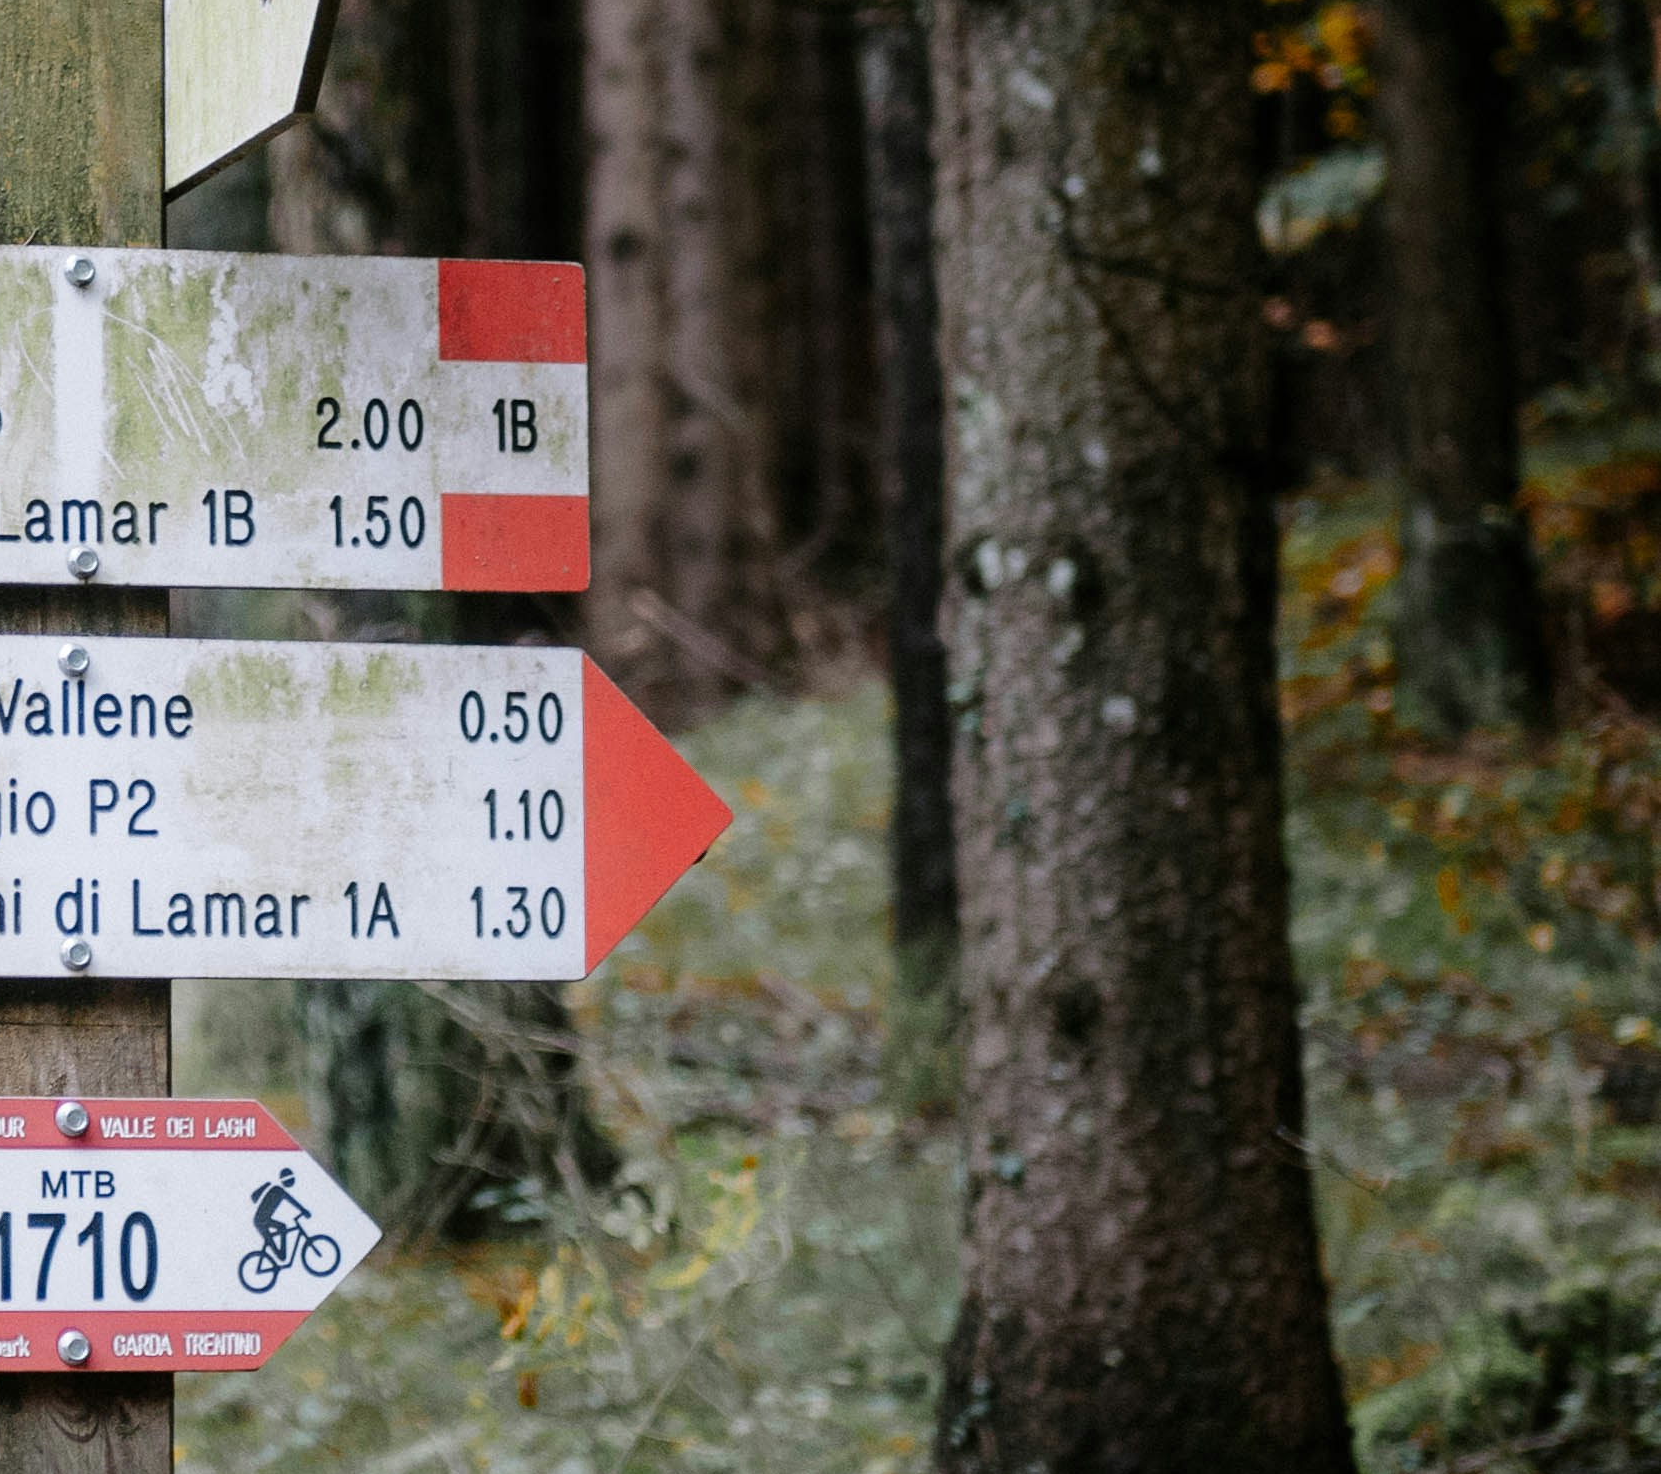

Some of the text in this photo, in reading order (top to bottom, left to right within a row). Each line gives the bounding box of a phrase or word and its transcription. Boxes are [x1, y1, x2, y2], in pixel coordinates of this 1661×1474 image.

[314, 395, 425, 453] 2.00
[490, 397, 540, 455] 1B
[201, 488, 256, 548] 1B
[328, 494, 427, 551] 1.50
[458, 689, 564, 745] 0.50
[88, 777, 160, 837] P2
[482, 787, 565, 842] 1.10
[54, 876, 100, 937] di
[131, 877, 312, 939] Lamar
[342, 880, 401, 939] 1A
[469, 885, 567, 940] 1.30
[99, 1116, 156, 1139] VALLE
[165, 1116, 195, 1139] DEI
[204, 1116, 256, 1139] LAGHI
[41, 1169, 117, 1200] MTB
[112, 1333, 174, 1357] GARDA
[183, 1332, 261, 1356] TRENTINO
